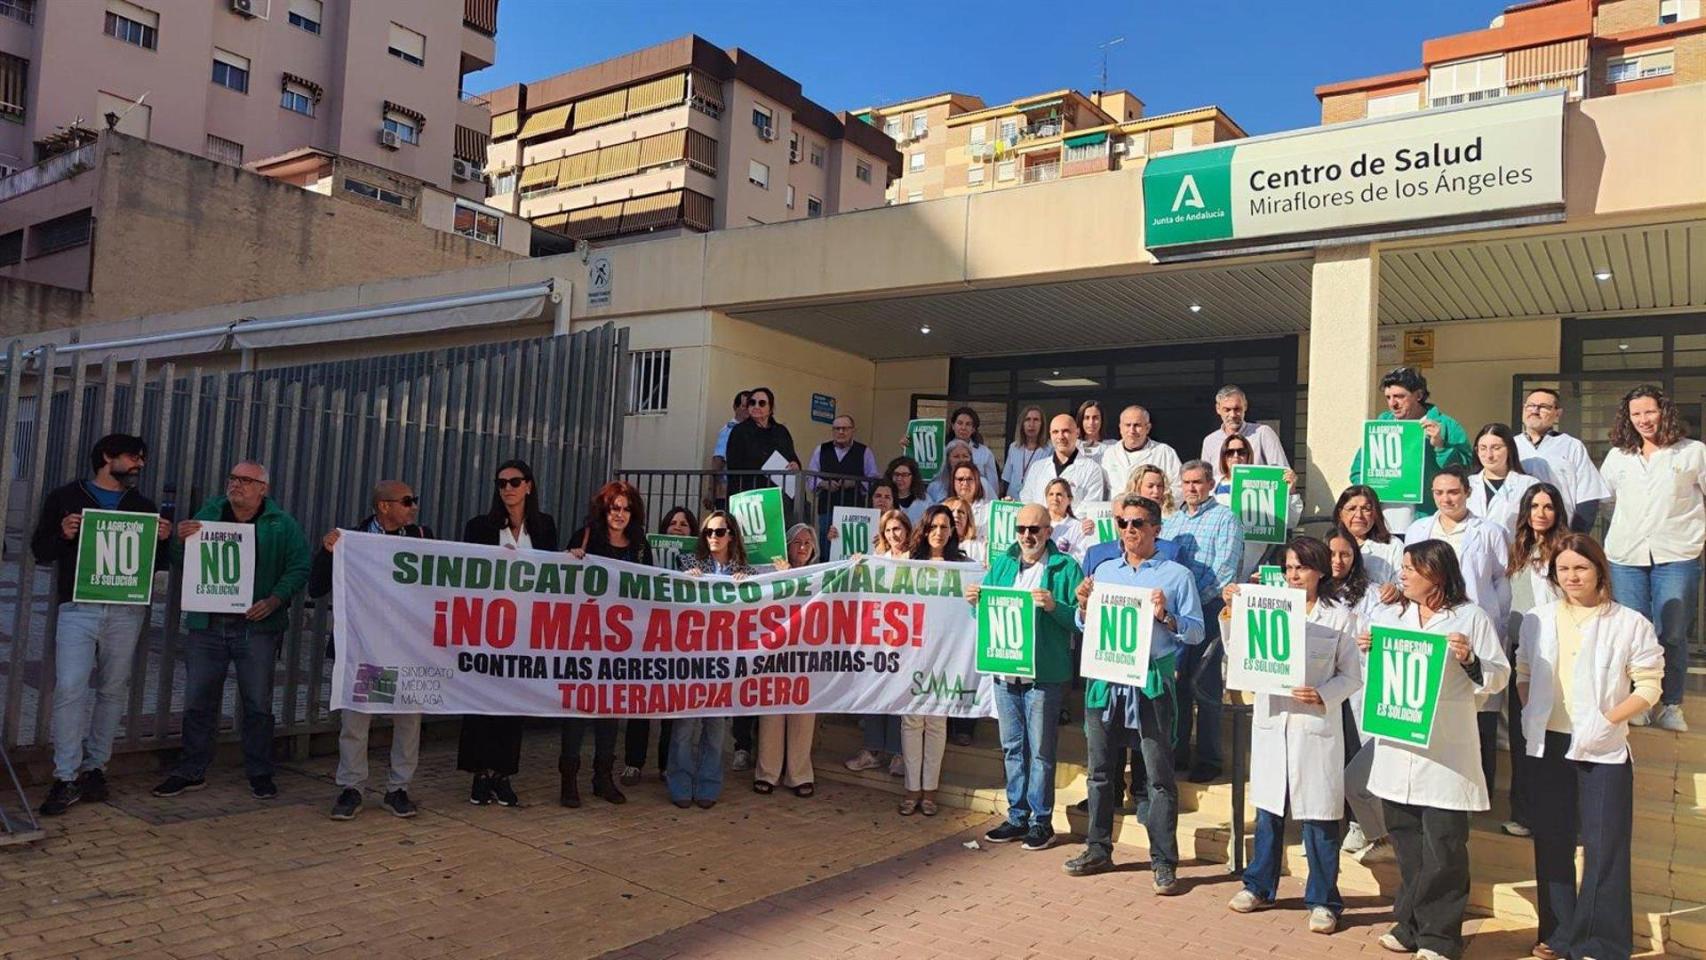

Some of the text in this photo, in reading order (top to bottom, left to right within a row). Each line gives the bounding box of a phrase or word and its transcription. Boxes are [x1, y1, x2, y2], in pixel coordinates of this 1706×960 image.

[1250, 136, 1482, 191] Centro de Salud
[1250, 165, 1533, 216] Miraflores de los Ángeles
[1152, 208, 1225, 226] Junta de Andalucía
[913, 431, 937, 462] NO
[1369, 433, 1402, 468] NO
[96, 520, 144, 533] LA AGRESIÓN
[734, 501, 767, 536] NO
[201, 530, 242, 543] LA AGRESIÓN
[841, 522, 868, 555] NO
[96, 531, 140, 576] NO
[200, 541, 241, 585] NO
[90, 574, 100, 585] ES
[196, 584, 205, 595] ES
[392, 552, 963, 603] SINDICATO MÉDICO DE MÁLAGA
[1101, 593, 1110, 604] LA
[1247, 596, 1292, 612] LA AGRESIÓN
[433, 596, 925, 653] ¡NO MÁS AGRESIONES!
[988, 606, 1024, 650] NO
[1100, 606, 1138, 653] NO
[1247, 608, 1290, 661] NO
[1383, 636, 1433, 656] LA AGRESIÓN
[401, 666, 454, 679] SINDICATO
[457, 650, 900, 681] CONTRA LAS AGRESIONES A SANITARIAS-OS
[1243, 659, 1253, 671] ES
[1382, 649, 1428, 709] NO
[558, 676, 811, 714] TOLERANCIA CERO
[1376, 702, 1423, 724] ES SOLUCIÓN
